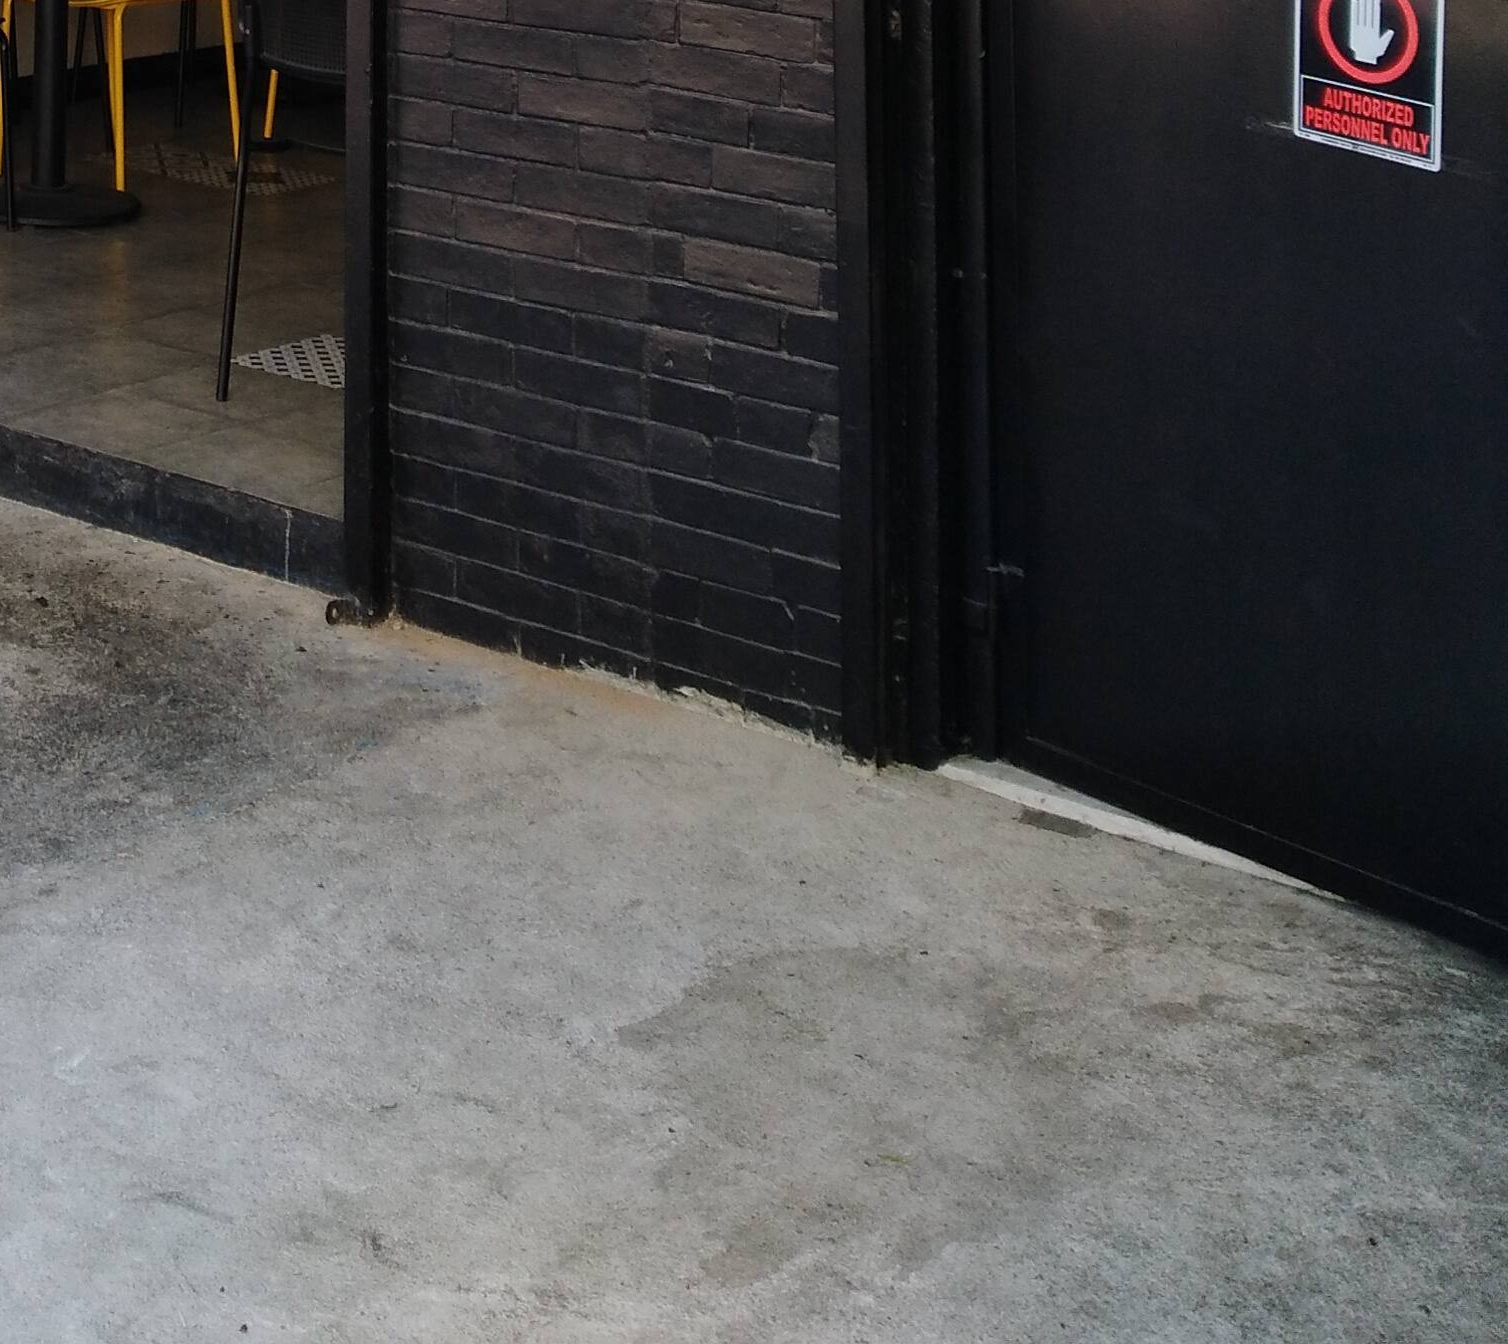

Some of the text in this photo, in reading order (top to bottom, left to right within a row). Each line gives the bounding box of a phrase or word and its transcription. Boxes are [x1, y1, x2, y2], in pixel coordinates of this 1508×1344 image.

[1323, 87, 1415, 127] AUTHORIZED
[1305, 105, 1389, 146] PERSONNEL
[1391, 130, 1431, 156] ONLY
